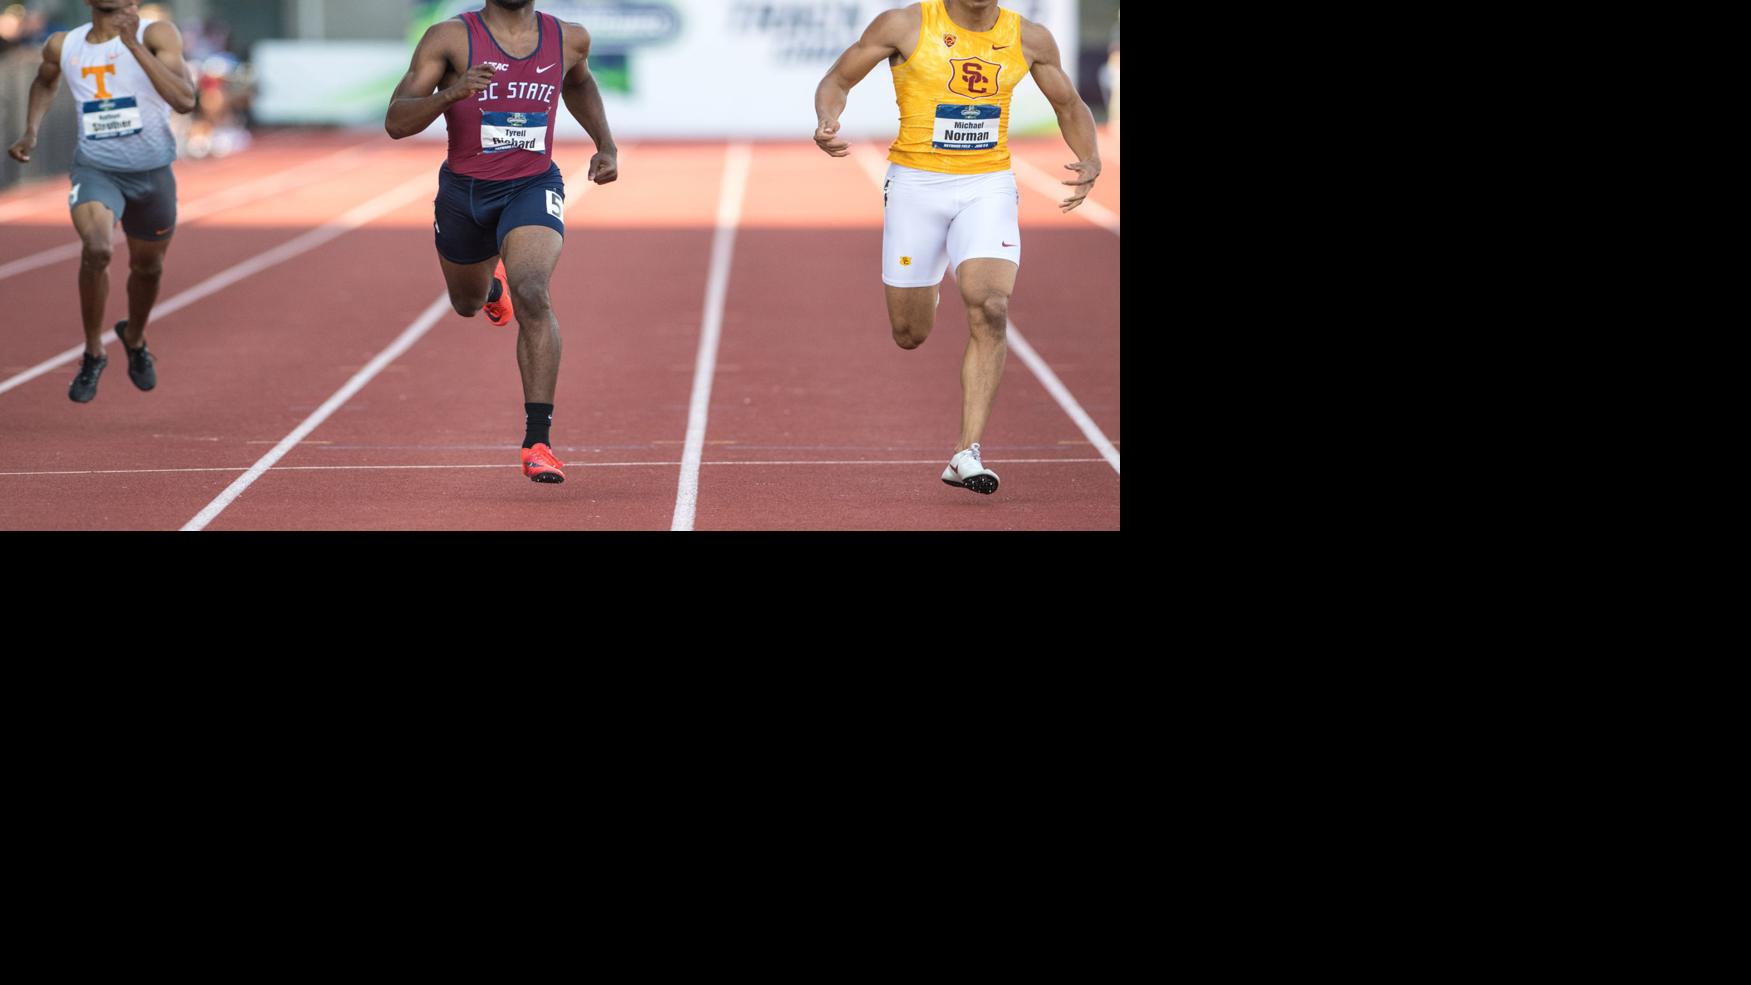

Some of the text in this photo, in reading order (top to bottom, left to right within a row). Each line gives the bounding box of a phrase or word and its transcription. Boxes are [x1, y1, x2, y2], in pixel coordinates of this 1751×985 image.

[81, 64, 116, 99] T
[962, 62, 989, 94] SC
[507, 81, 555, 103] STATE
[505, 129, 527, 137] Tyrell
[944, 130, 989, 141] Norman
[954, 121, 984, 129] Michael
[552, 192, 561, 218] 5
